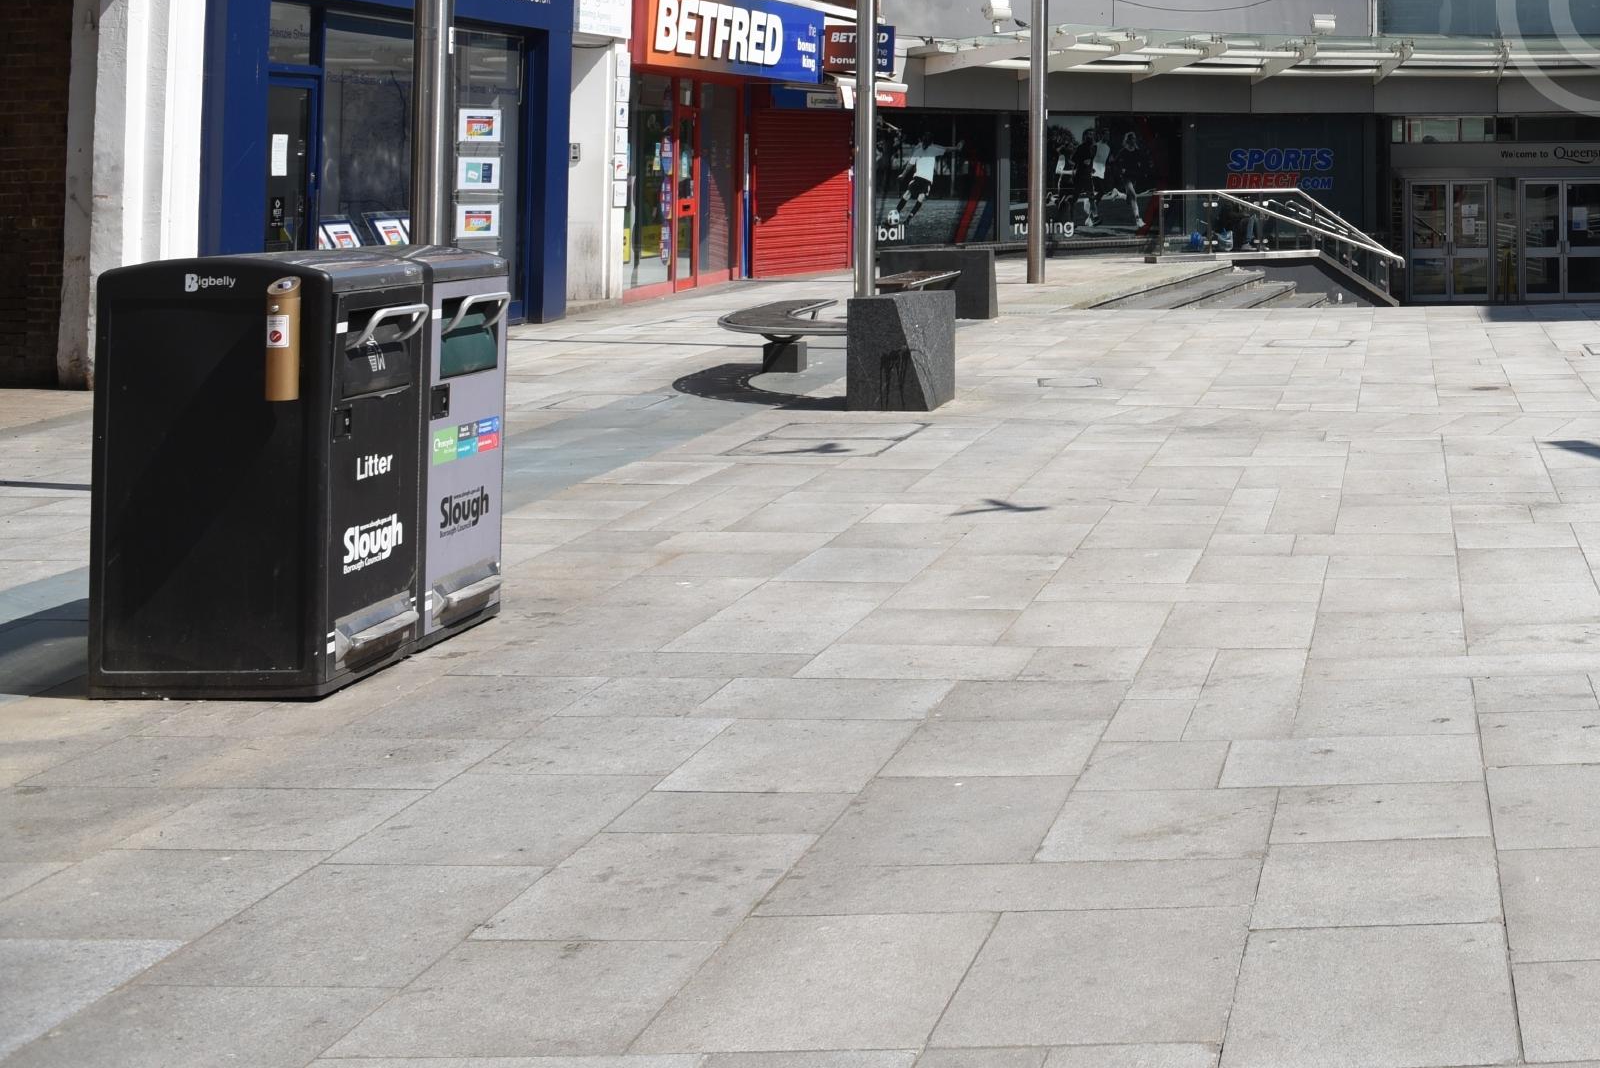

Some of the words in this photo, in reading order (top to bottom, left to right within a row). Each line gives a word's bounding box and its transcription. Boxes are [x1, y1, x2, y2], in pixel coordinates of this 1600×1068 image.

[809, 24, 817, 37] the
[831, 32, 889, 43] BETED
[797, 38, 816, 53] bonus
[877, 47, 888, 57] he
[802, 53, 816, 72] king
[830, 55, 857, 65] bonu
[1226, 148, 1335, 172] SPORTS
[1501, 150, 1537, 159] Welcome
[1540, 150, 1549, 159] to
[876, 224, 905, 242] ball
[184, 273, 236, 292] Bigbelly
[356, 453, 394, 481] Litter
[439, 485, 490, 529] Slough
[343, 512, 403, 564] Slough
[343, 560, 365, 575] Borough
[364, 552, 382, 566] Council
